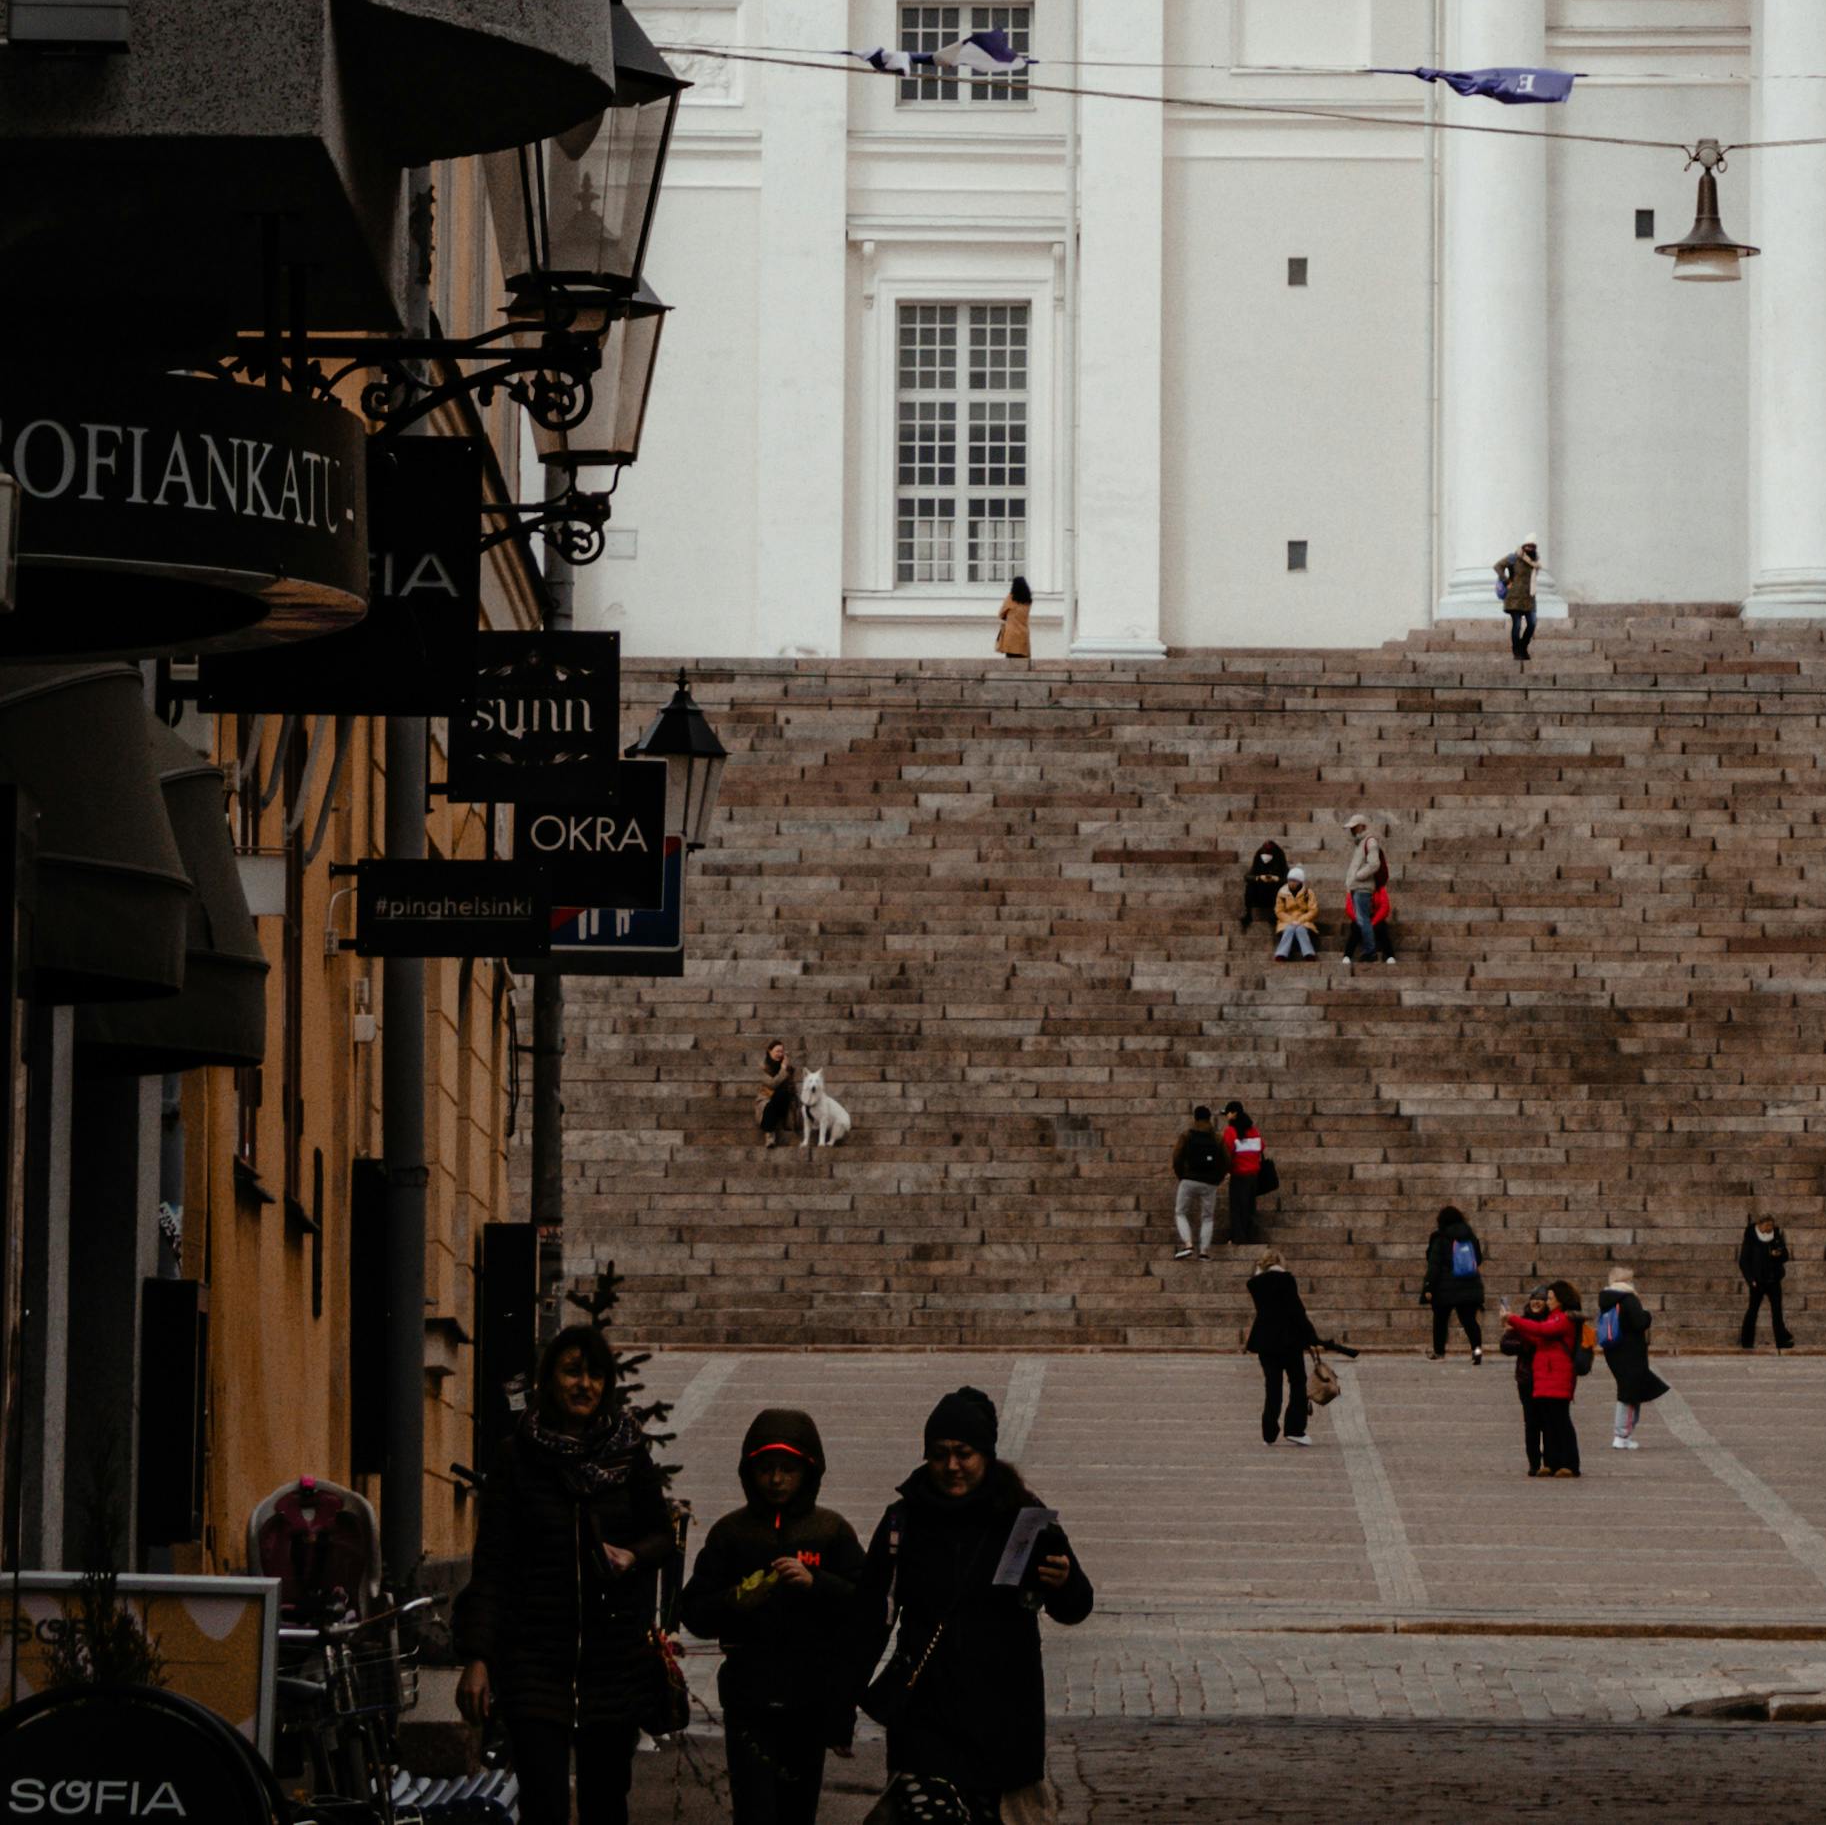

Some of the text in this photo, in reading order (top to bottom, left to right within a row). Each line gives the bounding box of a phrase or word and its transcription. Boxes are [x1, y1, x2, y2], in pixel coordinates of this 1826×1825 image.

[0, 416, 341, 536] OFIANKATU
[529, 814, 649, 854] OKRA
[374, 895, 534, 921] #pinghelsinki
[8, 1775, 188, 1818] SOFIA
